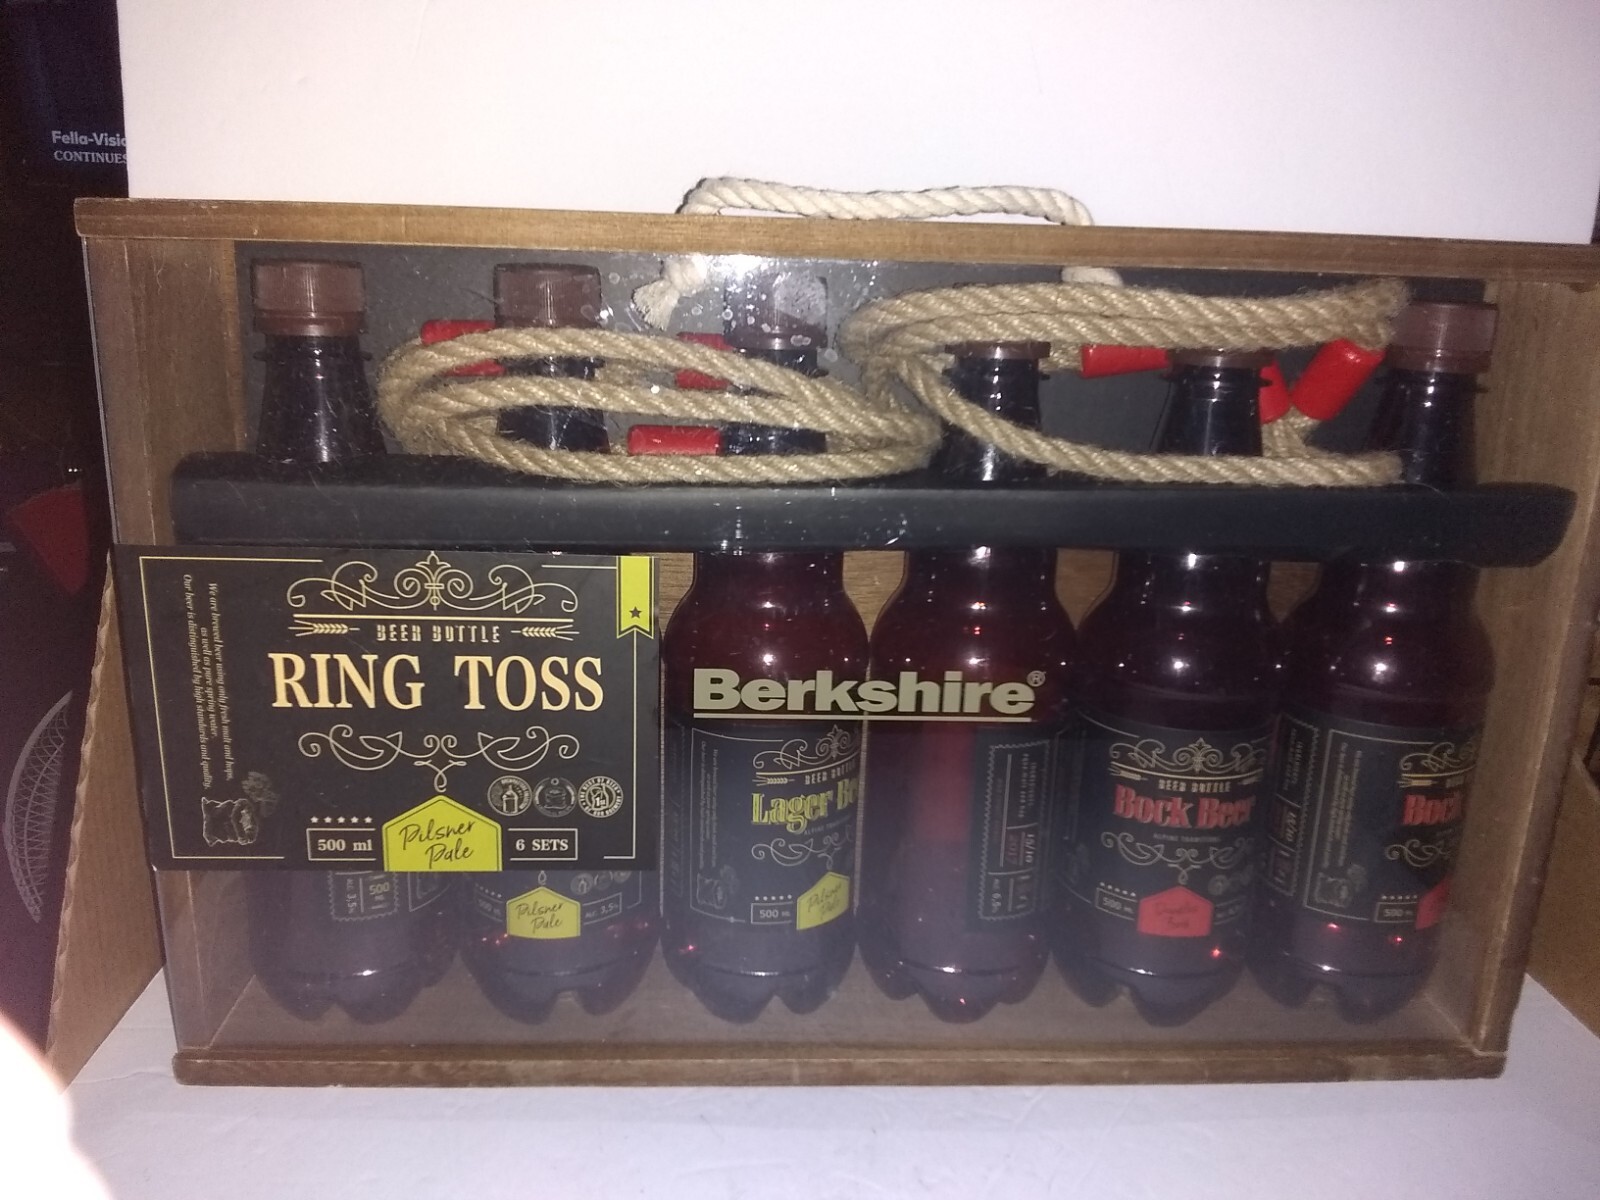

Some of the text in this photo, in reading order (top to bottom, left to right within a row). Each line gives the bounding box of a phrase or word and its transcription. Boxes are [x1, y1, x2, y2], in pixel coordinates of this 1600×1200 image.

[183, 574, 193, 591] Our
[208, 583, 218, 596] We
[185, 592, 195, 611] beer
[209, 597, 218, 612] are
[187, 611, 196, 620] is
[200, 626, 209, 636] as
[211, 613, 224, 643] brewed
[376, 624, 501, 643] BEER BOTTLE
[187, 620, 202, 673] distinguished
[201, 638, 212, 655] well
[214, 644, 224, 662] beer
[203, 656, 211, 666] as
[192, 674, 202, 684] by
[202, 667, 213, 686] pure
[215, 663, 226, 684] using
[268, 652, 604, 711] RING TOSS
[192, 685, 205, 704] high
[205, 687, 217, 712] spring
[218, 686, 229, 704] only
[219, 703, 231, 724] fresh
[196, 704, 209, 743] standards
[222, 725, 233, 743] malt
[201, 744, 212, 760] and
[224, 744, 235, 760] and
[1158, 778, 1187, 792] BEER
[751, 790, 834, 834] Lager
[1113, 783, 1194, 828] Bock
[399, 819, 476, 850] Pilsner
[317, 838, 373, 851] 500 ml
[515, 839, 569, 851] 6 SETS
[424, 839, 474, 869] Pale
[369, 881, 390, 895] 500
[515, 902, 563, 920] Pilsner
[759, 908, 780, 920] 500
[530, 916, 563, 933] Pale
